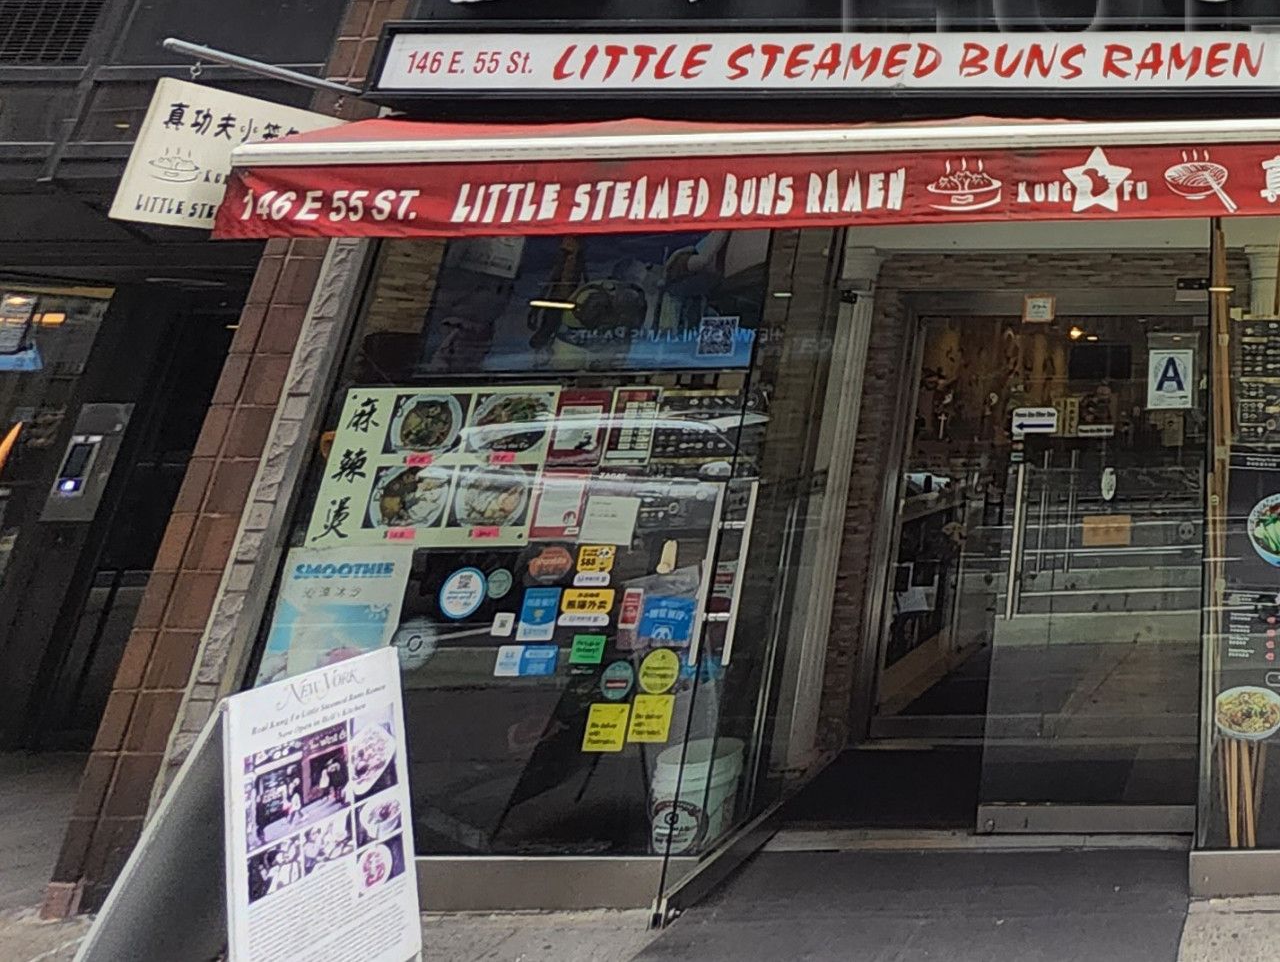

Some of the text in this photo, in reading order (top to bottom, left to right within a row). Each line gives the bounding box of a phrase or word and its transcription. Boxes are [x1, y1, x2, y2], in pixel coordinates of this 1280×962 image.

[407, 42, 1265, 83] 146 E. 55 St. LITTLE STEAMED BUNS RAMEN
[135, 194, 185, 214] LITTLE
[241, 166, 907, 223] 146 E 55 ST. LITTLE STEAMED BUNS RAMEN
[1017, 180, 1149, 204] KUNG FU
[1155, 356, 1185, 392] A
[294, 561, 395, 580] SMOOTHIE
